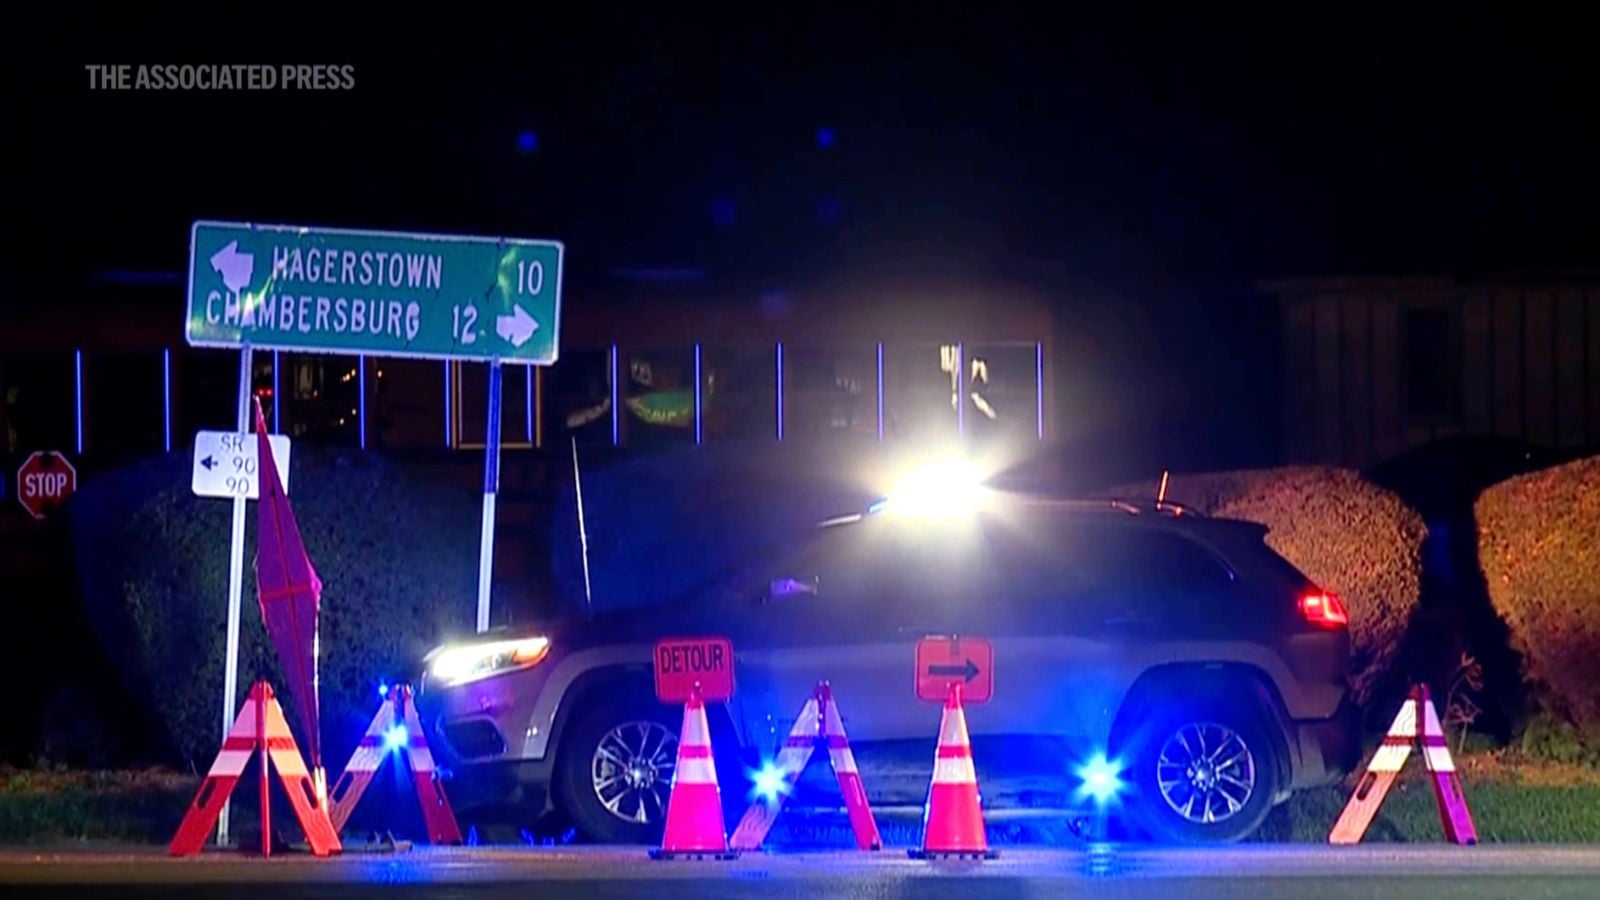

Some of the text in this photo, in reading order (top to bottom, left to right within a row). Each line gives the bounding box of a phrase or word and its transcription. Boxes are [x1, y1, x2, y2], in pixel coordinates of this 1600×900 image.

[272, 246, 544, 296] HAGERSTOWN 10
[206, 289, 478, 344] CHAMBERSBURG 12
[221, 434, 242, 452] SR
[25, 472, 67, 497] STOP
[225, 477, 249, 496] 90
[660, 644, 723, 673] DETOUR
